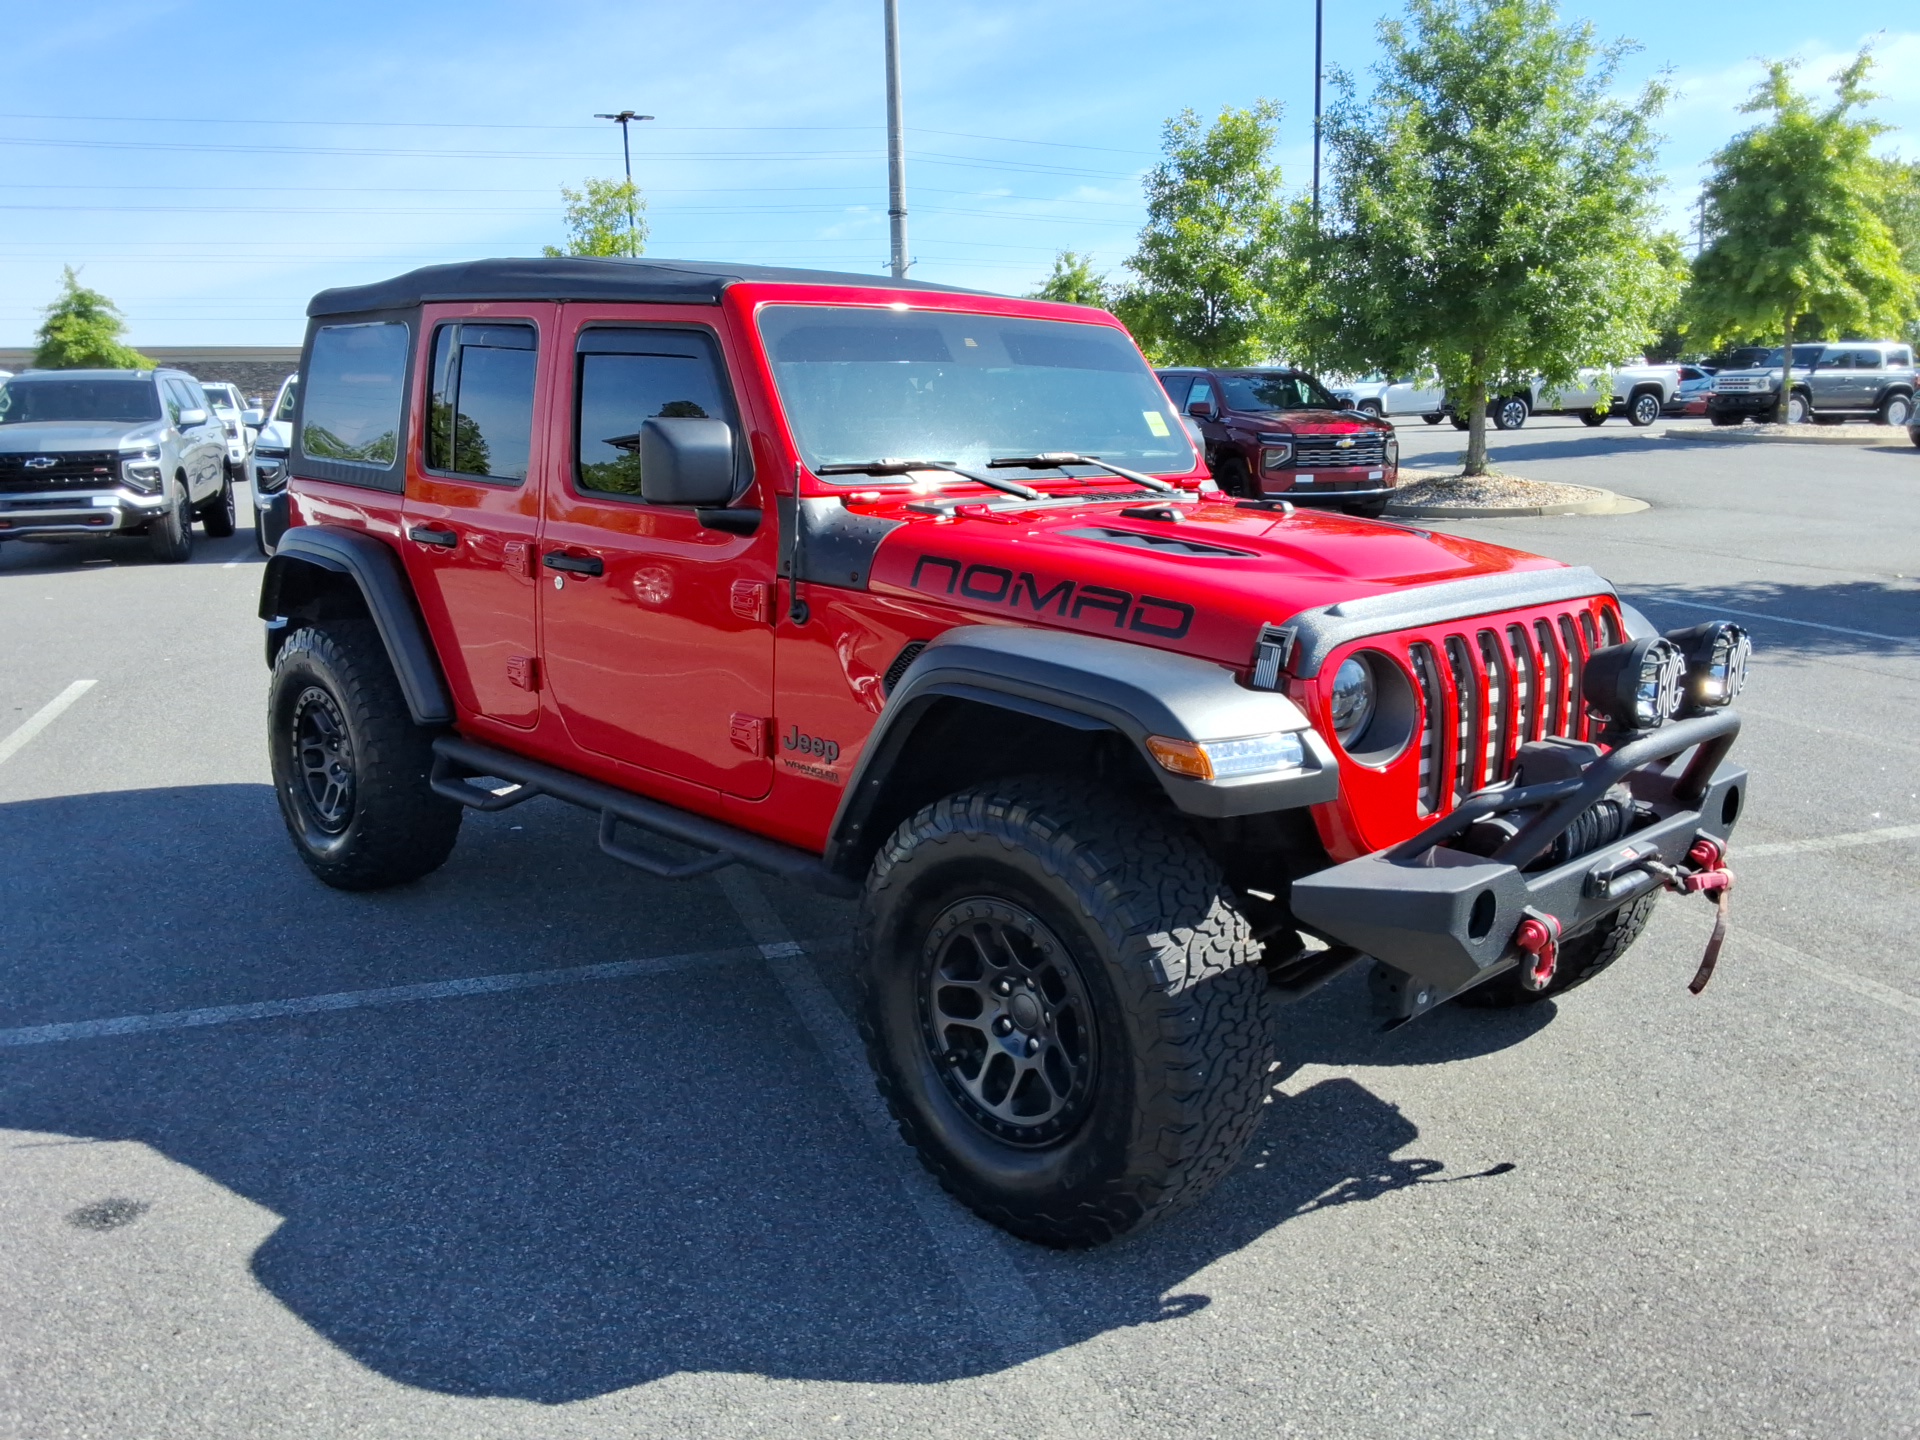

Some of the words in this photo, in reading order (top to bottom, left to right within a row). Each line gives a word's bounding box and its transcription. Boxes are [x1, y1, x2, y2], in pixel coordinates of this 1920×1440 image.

[910, 554, 1196, 640] NOMAD
[1656, 650, 1687, 719] KC
[1726, 636, 1752, 698] KC
[783, 724, 840, 765] Jeep
[783, 758, 839, 782] WRANGLER
